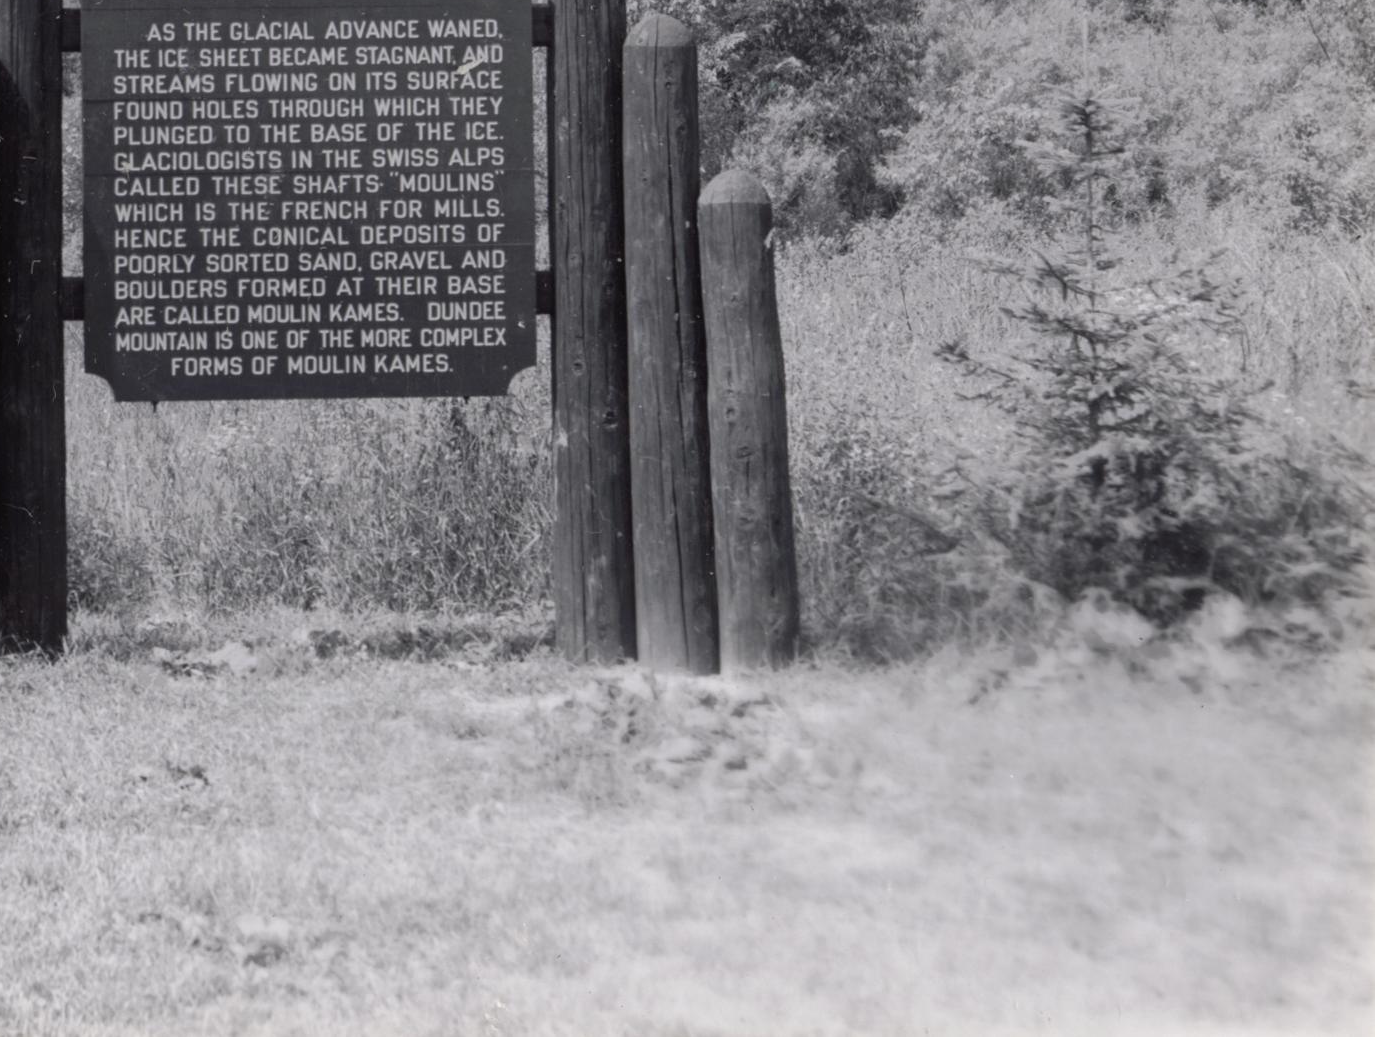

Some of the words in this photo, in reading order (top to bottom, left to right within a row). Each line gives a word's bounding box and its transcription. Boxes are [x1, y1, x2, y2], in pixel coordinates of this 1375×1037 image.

[147, 22, 175, 42] AS
[184, 22, 222, 41] THE
[229, 21, 315, 41] GLACIAL
[324, 19, 419, 40] ADVANCE
[427, 18, 503, 39] WANED,
[114, 49, 151, 69] THE
[158, 48, 189, 69] ICE
[199, 47, 262, 67] SHEET
[269, 46, 349, 67] BECAME
[355, 45, 456, 65] STAGNANT,
[461, 43, 504, 65] AND
[113, 74, 215, 95] STREAMS
[225, 72, 318, 93] FLOWING
[328, 72, 356, 92] ON
[366, 71, 397, 91] ITS
[407, 70, 503, 91] SURFACE
[113, 100, 183, 121] FOUND
[192, 99, 259, 119] HOLES
[269, 98, 364, 118] THROUGH
[373, 97, 440, 117] WHICH
[449, 96, 503, 116] THEY
[114, 125, 213, 146] PLUNGED
[223, 124, 250, 144] TO
[260, 124, 301, 144] THE
[310, 122, 367, 143] BASE
[377, 122, 403, 142] OF
[415, 121, 455, 141] THE
[465, 121, 504, 141] ICE.
[114, 150, 282, 173] GLACIOLOGISTS
[291, 150, 313, 169] IN
[321, 149, 362, 169] THE
[372, 147, 439, 168] SWISS
[448, 146, 505, 167] ALPS
[114, 176, 200, 197] CALLED
[212, 175, 281, 195] THESE
[115, 203, 183, 222] WHICH
[196, 202, 216, 222] IS
[228, 201, 269, 221] THE
[281, 200, 368, 220] FRENCH
[379, 199, 422, 219] FOR
[434, 198, 504, 218] MILLS.
[115, 228, 187, 249] HENCE
[199, 227, 240, 247] THE
[253, 226, 349, 246] CONICAL
[360, 224, 466, 245] DEPOSITS
[477, 223, 505, 243] OF
[115, 254, 195, 274] POORLY
[206, 253, 289, 273] SORTED
[298, 251, 362, 272] SAND,
[370, 250, 452, 271] GRAVEL
[461, 249, 506, 269] AND
[115, 279, 227, 300] BOULDERS
[238, 277, 326, 298] FORMED
[336, 277, 364, 296] AT
[375, 276, 437, 296] THEIR
[447, 274, 505, 295] BASE
[115, 306, 156, 326] ARE
[164, 305, 240, 325] CALLED
[247, 304, 321, 324] MOULIN
[329, 302, 404, 322] KAMES.
[427, 300, 506, 321] DUNDEE
[116, 332, 208, 352] MOUNTAIN
[215, 329, 233, 350] IS
[241, 330, 278, 350] ONE
[286, 329, 310, 349] OF
[319, 329, 354, 348] THE
[361, 328, 412, 348] MORE
[420, 327, 506, 347] COMPLEX
[171, 356, 243, 376] FORMS
[251, 356, 278, 375] OF
[288, 355, 366, 375] MOULIN
[374, 353, 453, 373] KAMES.
